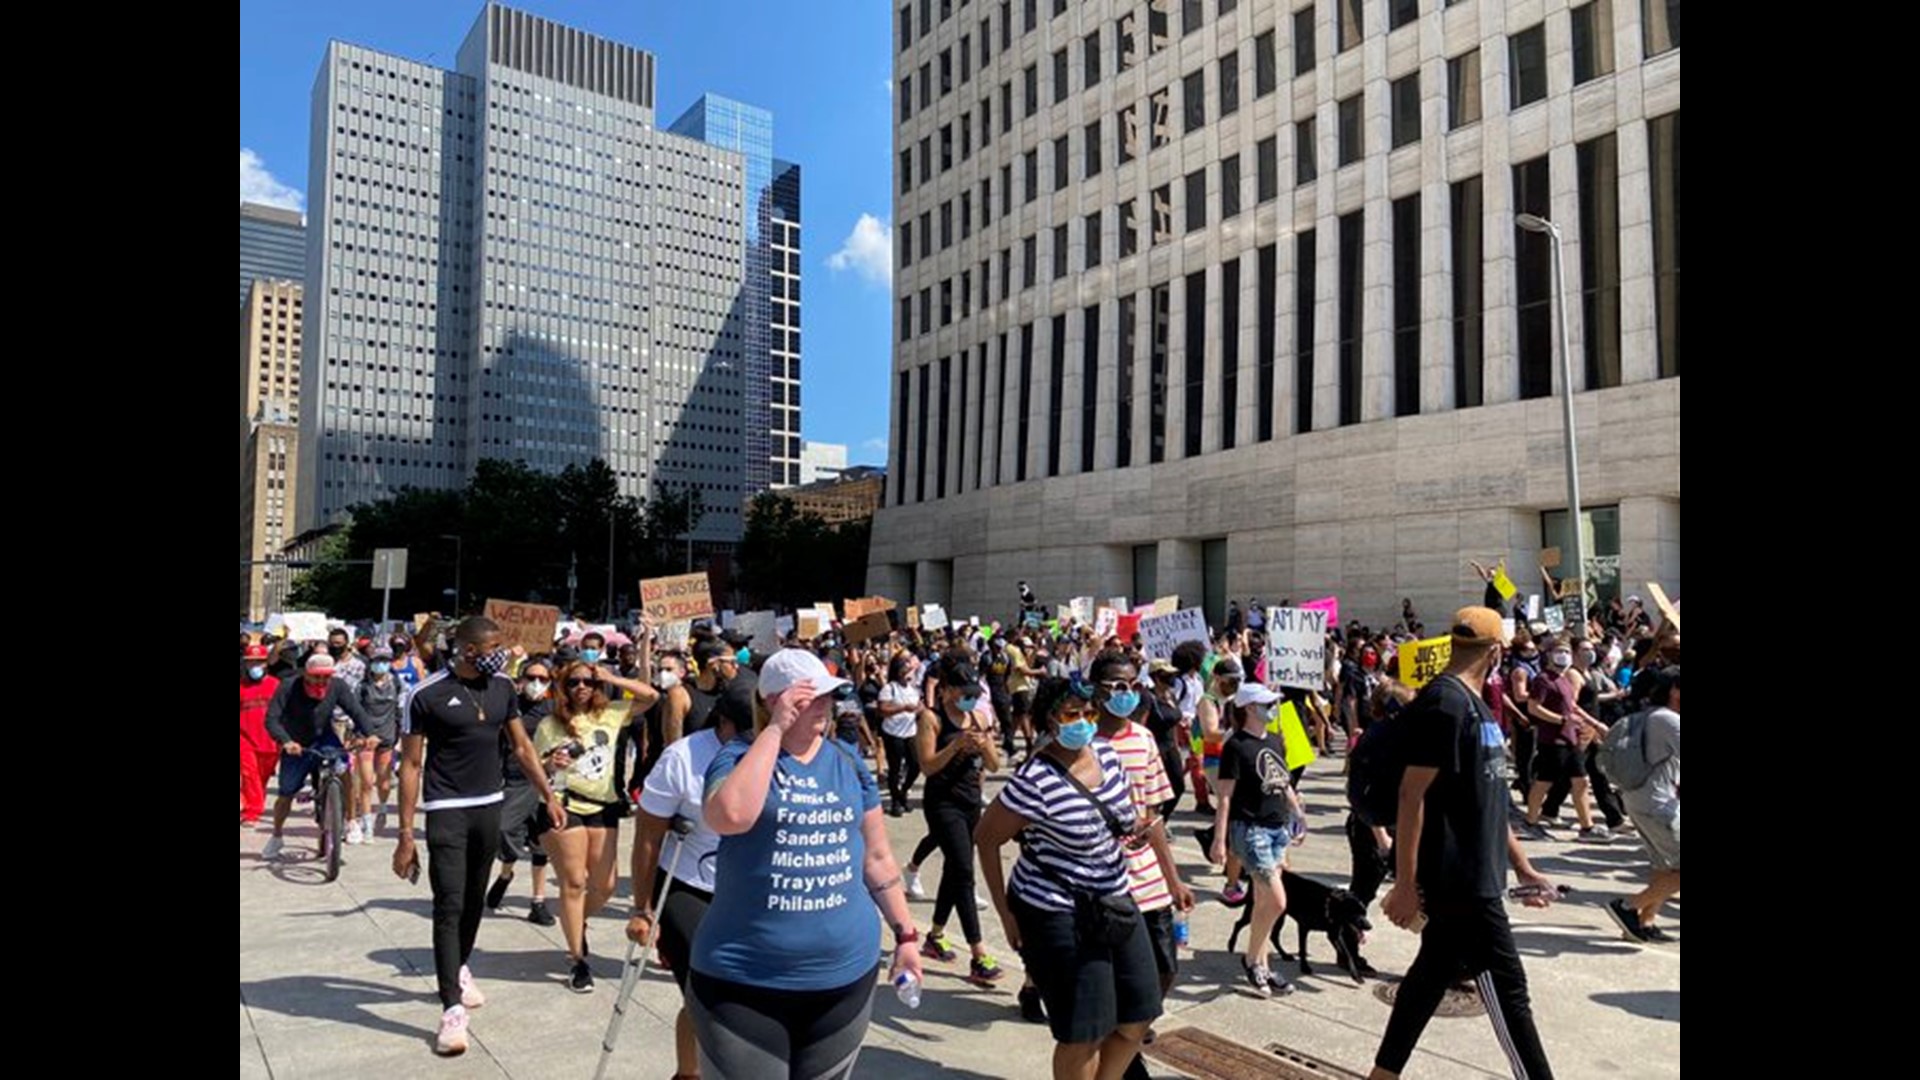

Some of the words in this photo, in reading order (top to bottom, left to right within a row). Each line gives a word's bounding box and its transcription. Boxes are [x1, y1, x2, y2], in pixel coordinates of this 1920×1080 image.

[644, 583, 662, 601] NO
[665, 579, 709, 597] JUSTICE
[646, 603, 667, 618] NO
[1271, 609, 1294, 632] AM
[1299, 610, 1327, 634] MY
[776, 806, 854, 826] Freddie&
[775, 827, 848, 847] Sandra&
